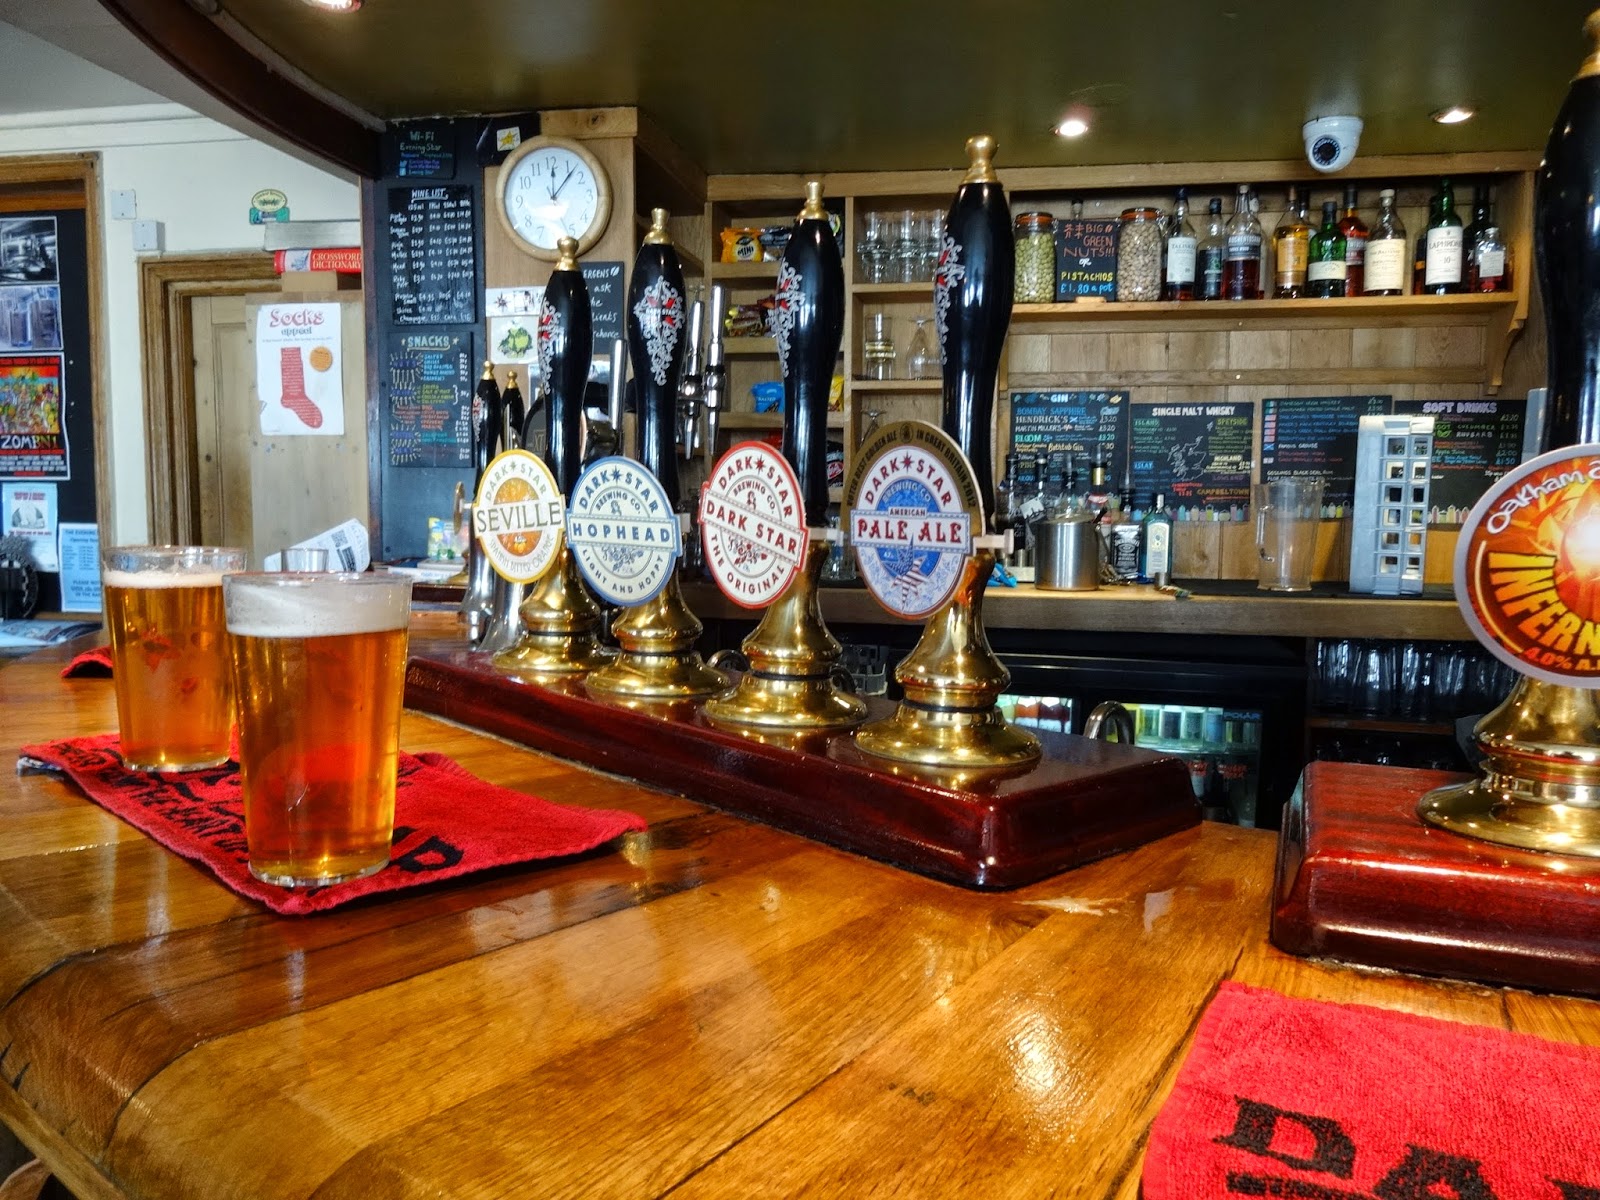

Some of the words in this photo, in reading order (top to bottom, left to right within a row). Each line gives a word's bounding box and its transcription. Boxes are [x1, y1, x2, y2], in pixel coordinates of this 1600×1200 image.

[531, 163, 541, 176] 11
[545, 156, 559, 170] 12
[565, 160, 570, 174] 1
[520, 175, 531, 190] 10
[577, 171, 585, 185] 2
[411, 188, 430, 198] WINE
[586, 188, 594, 204] 3
[516, 195, 523, 209] 9
[524, 215, 532, 228] 8
[580, 208, 588, 223] 4
[536, 226, 545, 240] 7
[568, 223, 576, 237] 5
[1085, 223, 1104, 233] BIG
[1083, 235, 1113, 247] GREEN
[312, 252, 362, 261] CROSSWORD
[737, 246, 754, 256] MINI
[312, 260, 361, 269] DICTIONARY
[1061, 271, 1114, 282] PISTACHIOS
[593, 282, 612, 293] ask
[1099, 283, 1113, 295] pot
[590, 296, 603, 307] he
[269, 308, 325, 328] Socks
[407, 336, 450, 348] SNACKS
[1050, 393, 1069, 403] GIN
[1016, 407, 1047, 416] BOMBAY
[1050, 406, 1087, 416] SAPPHIRE
[1152, 407, 1182, 417] SINGLE
[1182, 406, 1204, 416] MALT
[1206, 406, 1236, 416] WHISKY
[1422, 402, 1455, 414] SOFT
[1456, 402, 1498, 414] DRINKS
[1015, 415, 1069, 424] HENDRICK'S
[916, 429, 924, 440] IN
[1014, 434, 1042, 443] BLOOM
[1133, 461, 1154, 470] ISLAY
[485, 464, 508, 501] DARK
[520, 463, 547, 496] STAR
[718, 456, 753, 490] DARK
[766, 466, 793, 519] STAR
[865, 457, 900, 505] DARK
[916, 458, 952, 507] STAR
[579, 470, 611, 510] DARK
[625, 472, 659, 514] STAR
[733, 481, 767, 498] BREWING
[595, 491, 628, 511] BREWING
[1486, 467, 1585, 534] Oakham
[476, 501, 562, 533] SEVILLE
[889, 507, 926, 517] AMERICAN
[573, 522, 671, 543] HOPHEAD
[706, 499, 747, 532] DARK
[755, 523, 799, 556] STAR
[858, 518, 908, 541] PALE
[917, 521, 963, 544] ALE
[710, 534, 725, 568] THE
[727, 565, 785, 595] ORIGINAL
[582, 549, 608, 584] LIGHT
[612, 583, 634, 594] AND
[638, 555, 664, 590] HOPPY
[1575, 659, 1600, 671] A.
